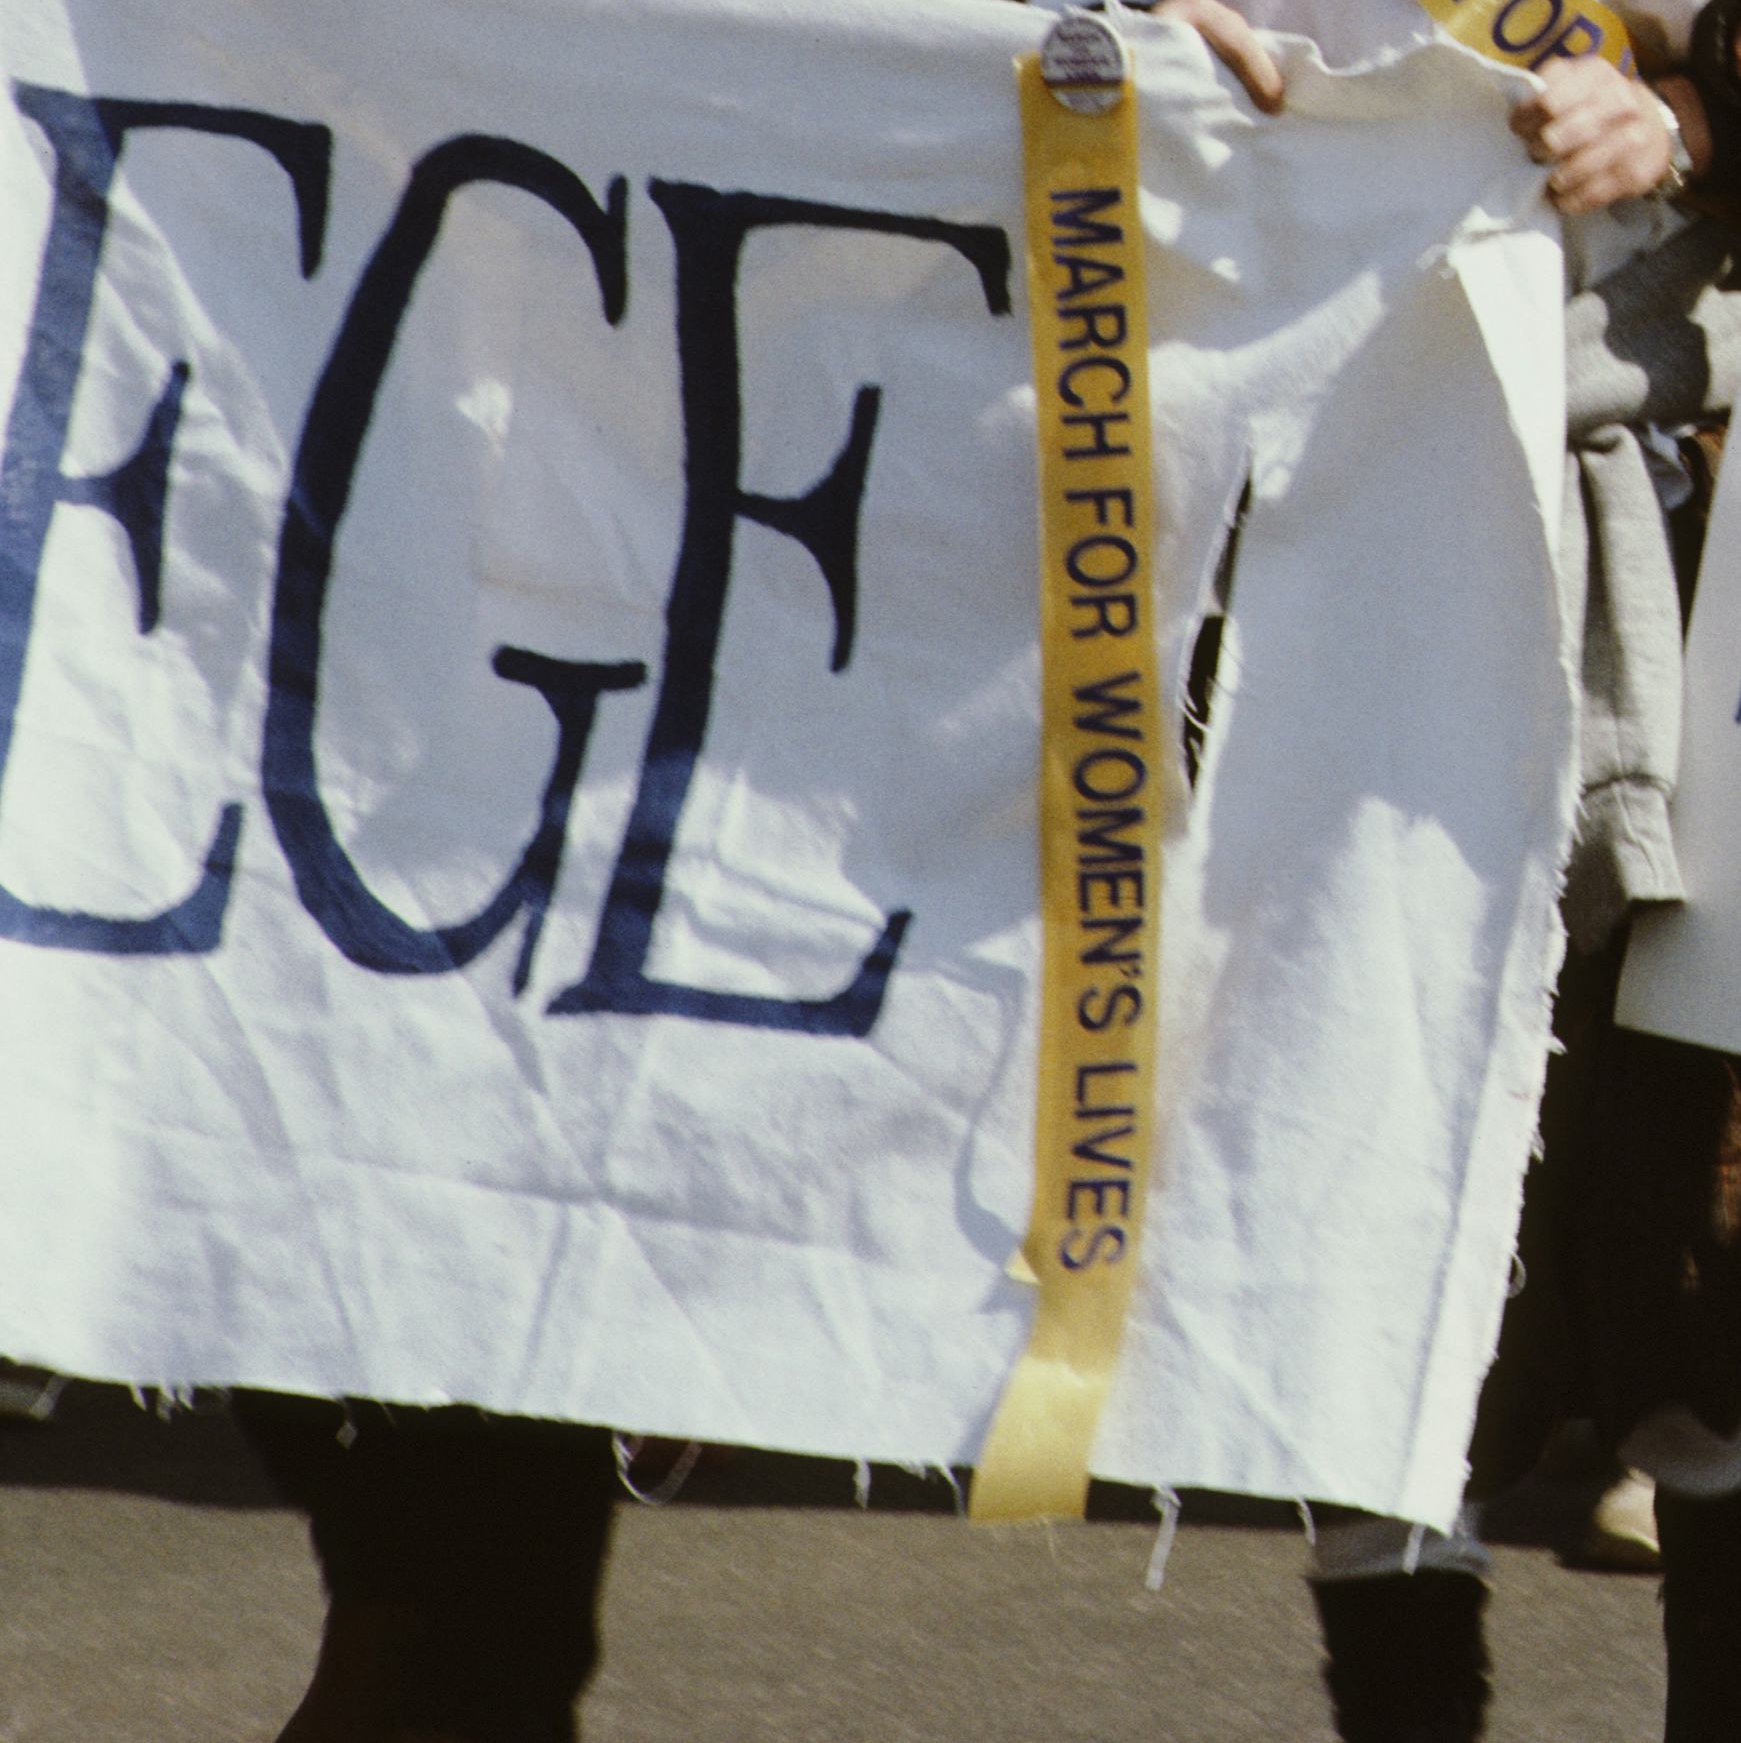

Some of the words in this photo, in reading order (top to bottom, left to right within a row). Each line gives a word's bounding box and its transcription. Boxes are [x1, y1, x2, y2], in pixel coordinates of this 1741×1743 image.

[1049, 186, 1133, 458] MARCH
[1064, 483, 1139, 642] FOR
[1070, 670, 1148, 1036] WOMEN'S
[1057, 1059, 1139, 1275] LIVES
